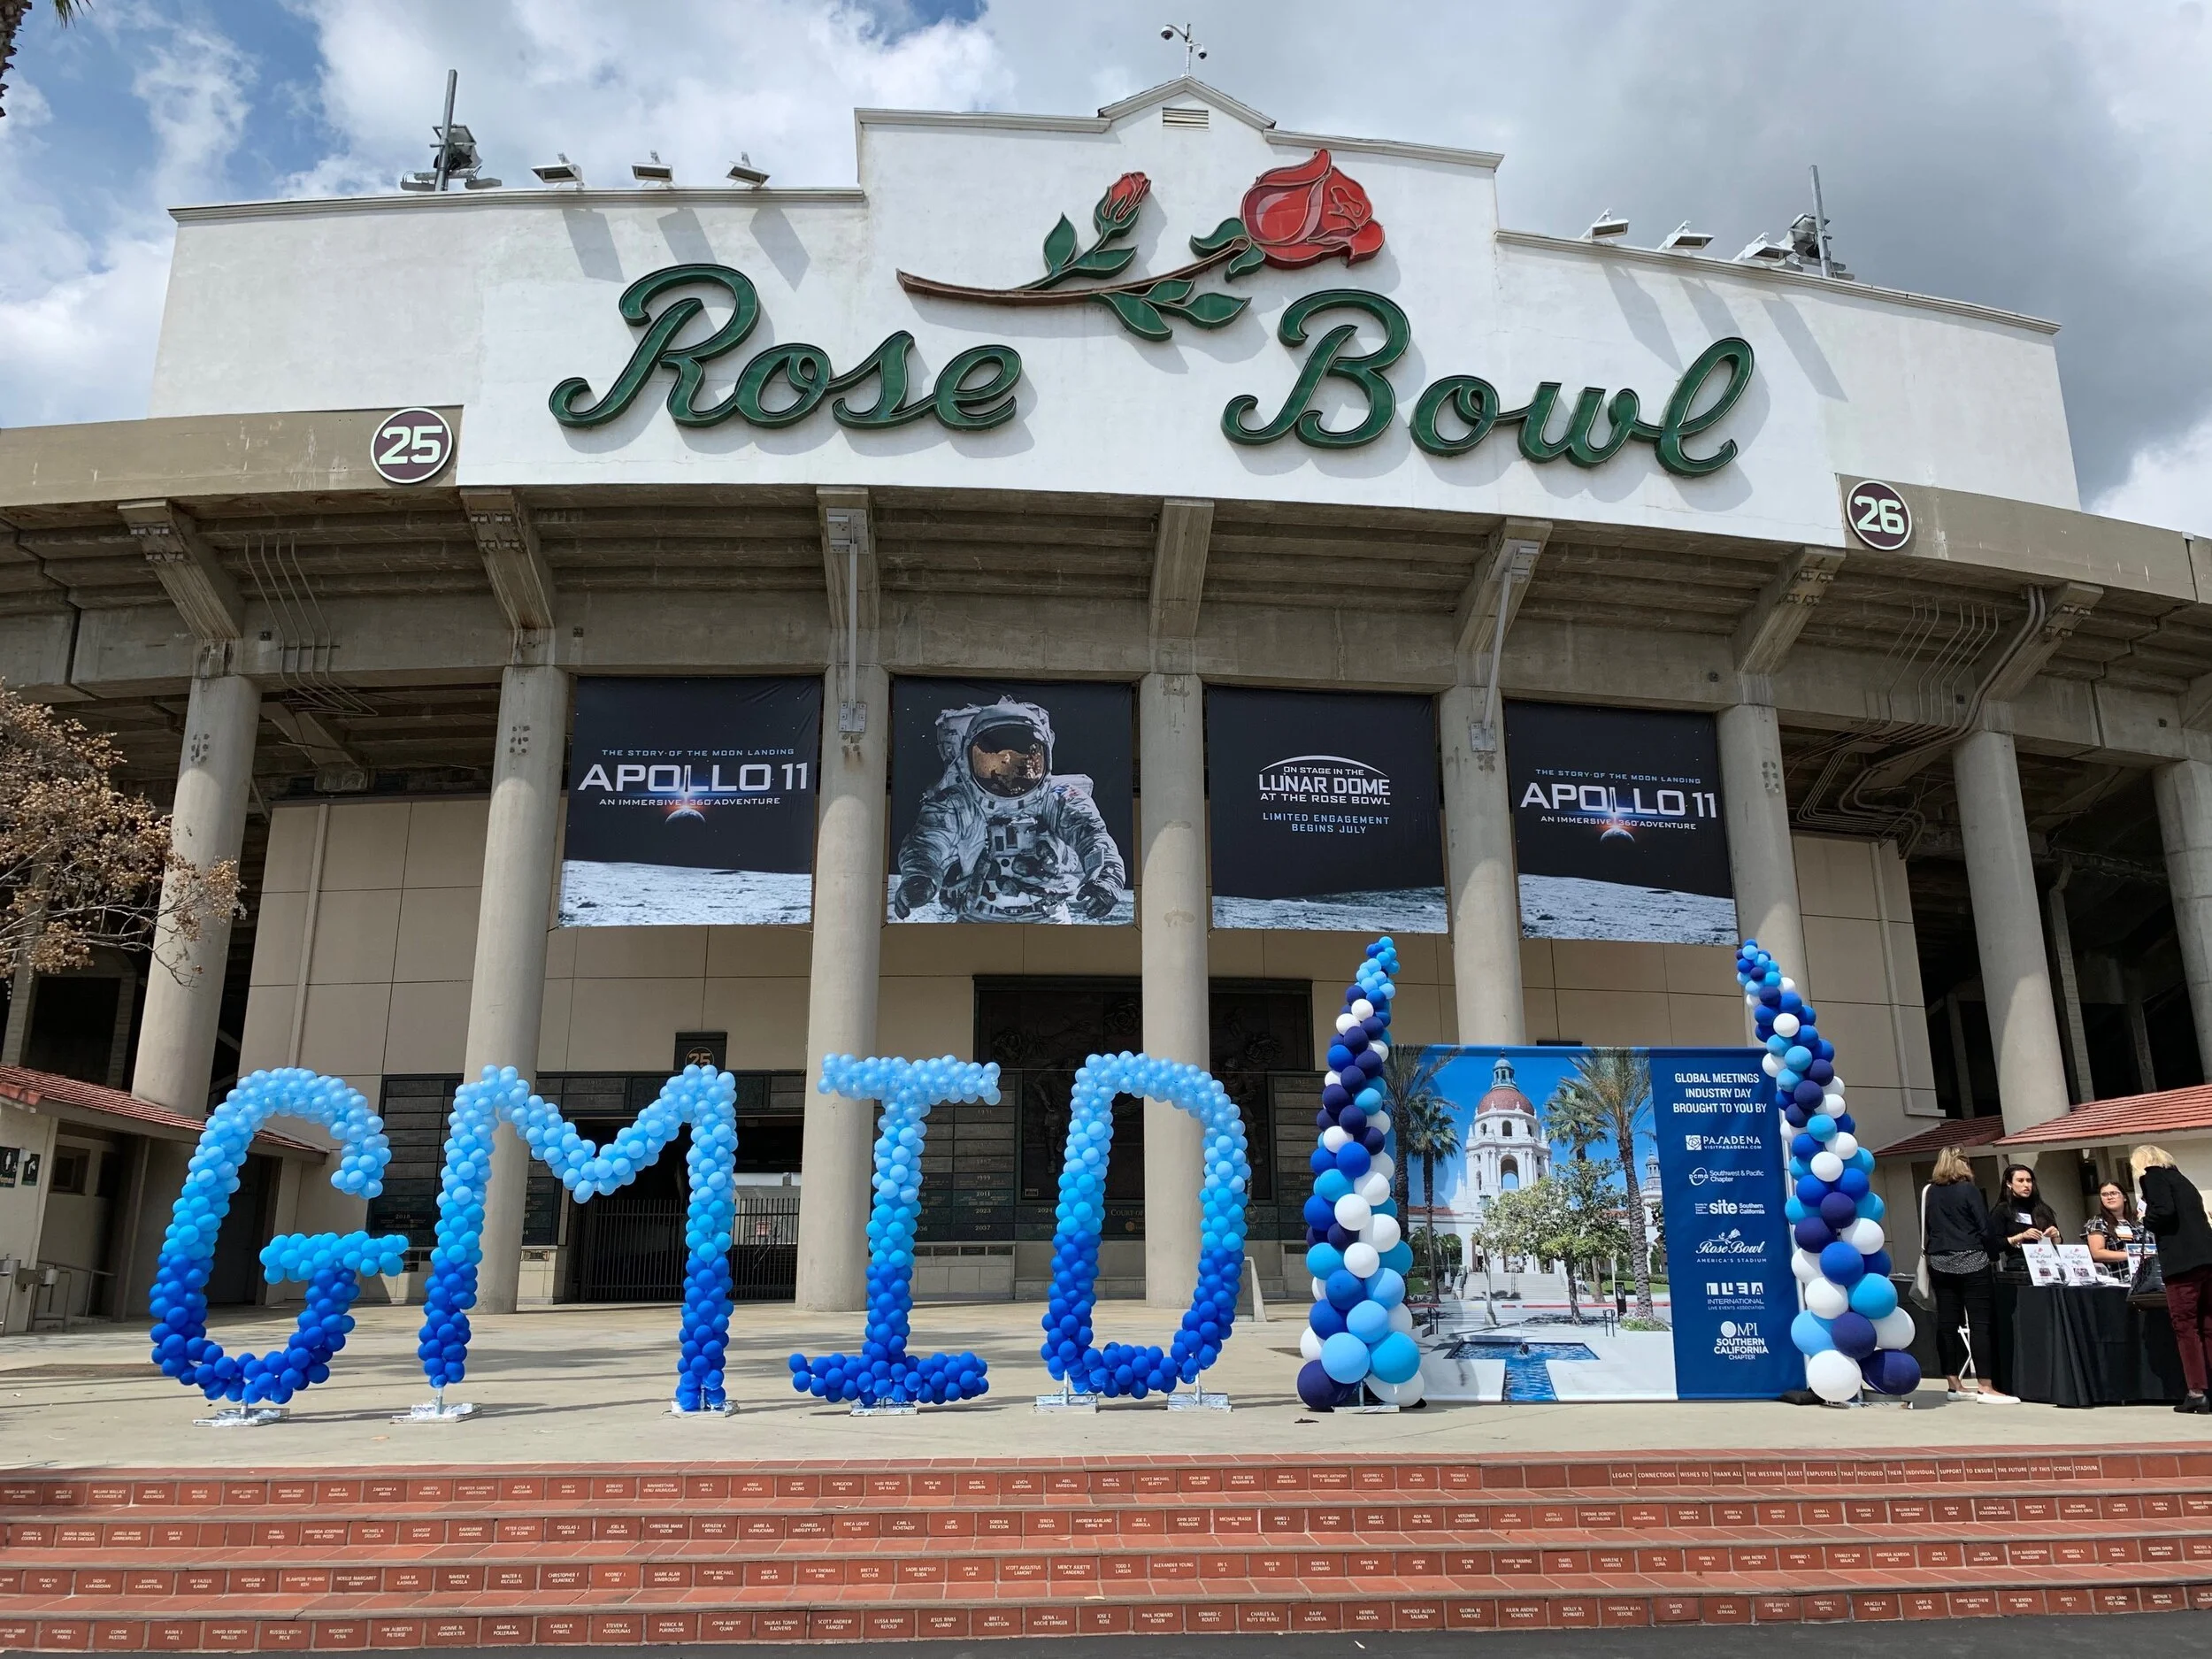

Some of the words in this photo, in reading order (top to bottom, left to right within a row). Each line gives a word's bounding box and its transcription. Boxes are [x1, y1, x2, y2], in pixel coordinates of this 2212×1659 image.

[549, 263, 1022, 430] Rose
[1220, 288, 1755, 477] Bowl
[379, 426, 442, 465] 25
[1854, 495, 1905, 535] 26
[1283, 765, 1297, 774] ON
[1300, 766, 1332, 775] STAGE
[577, 763, 772, 793] APOLLO
[781, 762, 808, 790] 11
[1259, 774, 1327, 794] LUNAR
[1333, 777, 1391, 795] DOME
[1281, 793, 1307, 803] THE
[1311, 795, 1348, 804] ROSE
[1351, 795, 1391, 805] BOWL
[1520, 782, 1686, 817] APOLLO
[1692, 792, 1717, 818] 11
[1263, 812, 1309, 822] LIMITED
[1313, 814, 1390, 825] ENGAGEMENT
[1557, 816, 1612, 826] IMMERSIVE
[1291, 824, 1333, 833] BEGINS
[1339, 826, 1367, 834] JULY
[1675, 1073, 1711, 1084] GLOBAL
[1712, 1073, 1760, 1084] MEETINGS
[1686, 1088, 1732, 1098] INDUSTRY
[1734, 1088, 1751, 1098] DAY
[1673, 1103, 1718, 1113] BROUGHT
[1720, 1103, 1732, 1113] TO
[1734, 1103, 1753, 1113] YOU
[1755, 1103, 1767, 1113] BY
[1703, 1135, 1762, 1145] PASADENA
[1709, 1199, 1738, 1214] site
[1695, 1240, 1728, 1254] Rose
[1728, 1240, 1766, 1254] Bowl
[1737, 1322, 1759, 1337] MPI
[1716, 1337, 1765, 1346] SOUTHERN
